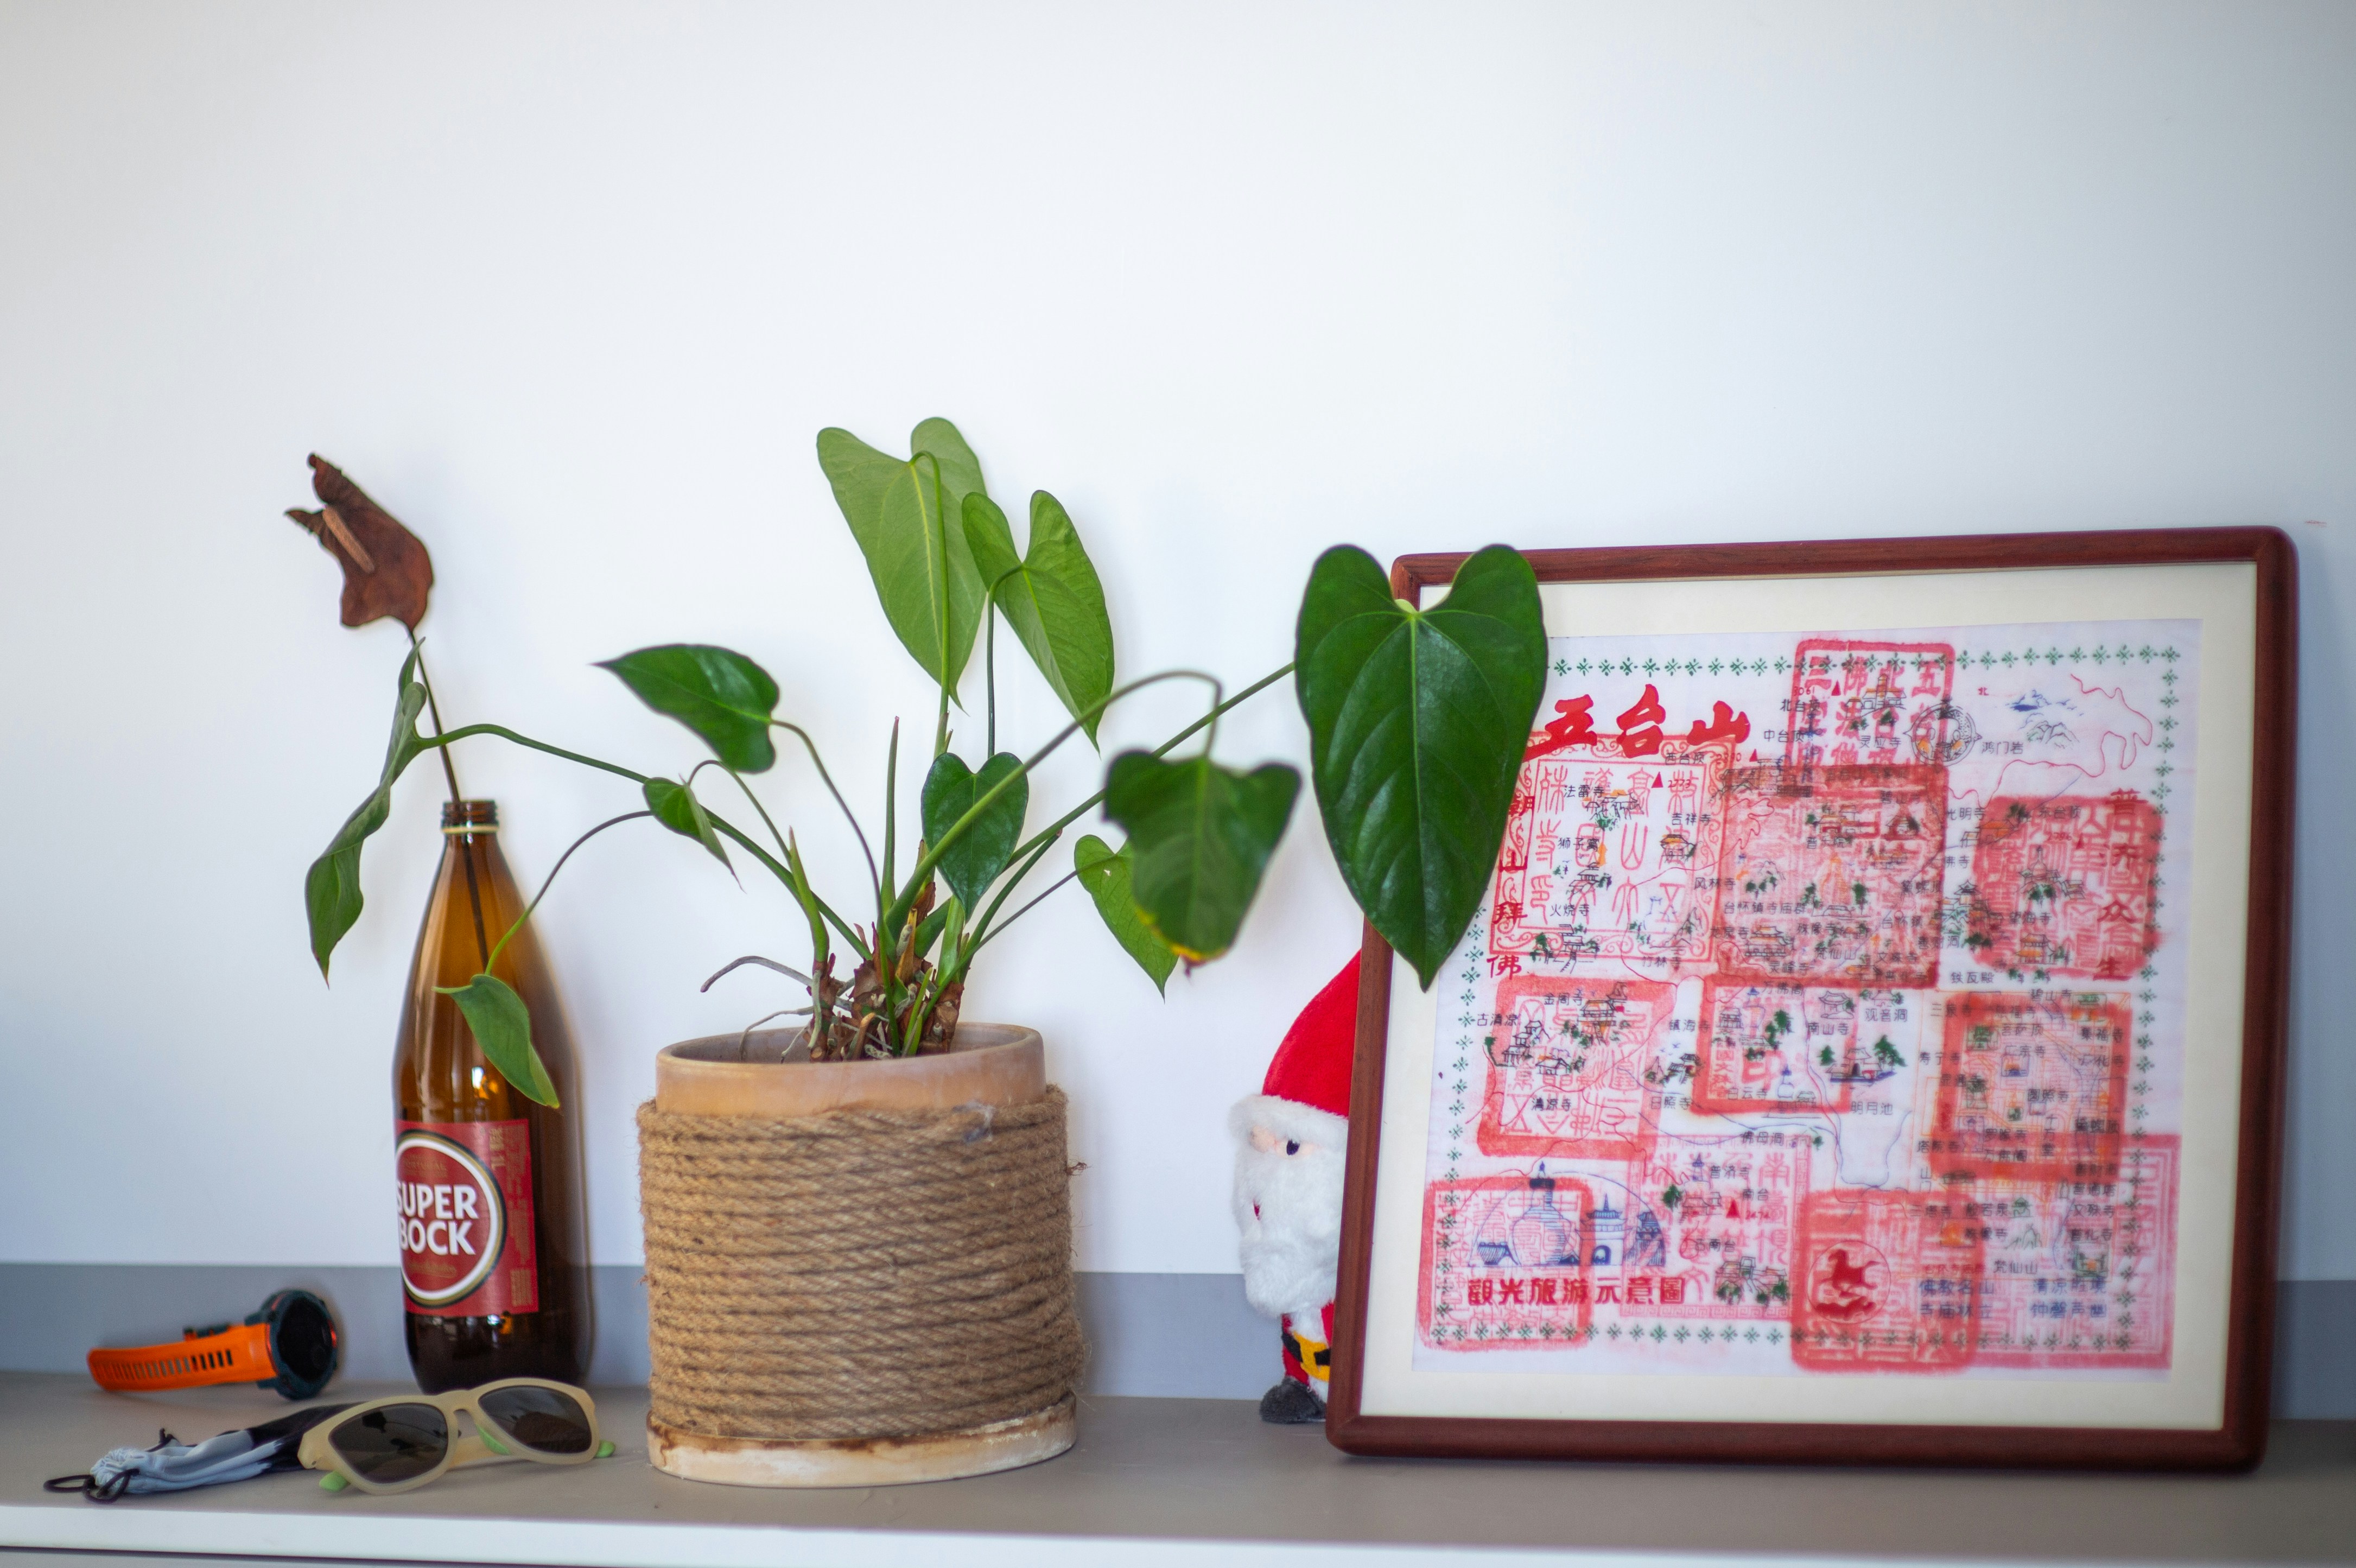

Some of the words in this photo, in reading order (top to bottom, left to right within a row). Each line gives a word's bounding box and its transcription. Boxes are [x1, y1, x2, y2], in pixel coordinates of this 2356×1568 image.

[1978, 686, 1989, 696] 北
[1523, 684, 1751, 760] 五台山
[1763, 729, 1805, 743] 中台顶
[1859, 735, 1902, 749] 灵应寺
[1982, 741, 2024, 755] 鸿门岩
[1563, 785, 1604, 798] 法雷寺
[1672, 813, 1711, 826] 吉祥寺
[1550, 904, 1590, 917] 火烧寺
[1724, 901, 1807, 915] 台怀镇寺庙群
[1865, 1008, 1908, 1023] 观音洞
[1807, 1022, 1850, 1036] 南山寺
[1726, 1085, 1768, 1100] 白云寺
[1850, 1101, 1894, 1115] 明月池
[1740, 1131, 1785, 1147] 佛母洞
[1709, 1165, 1750, 1179] 普济寺
